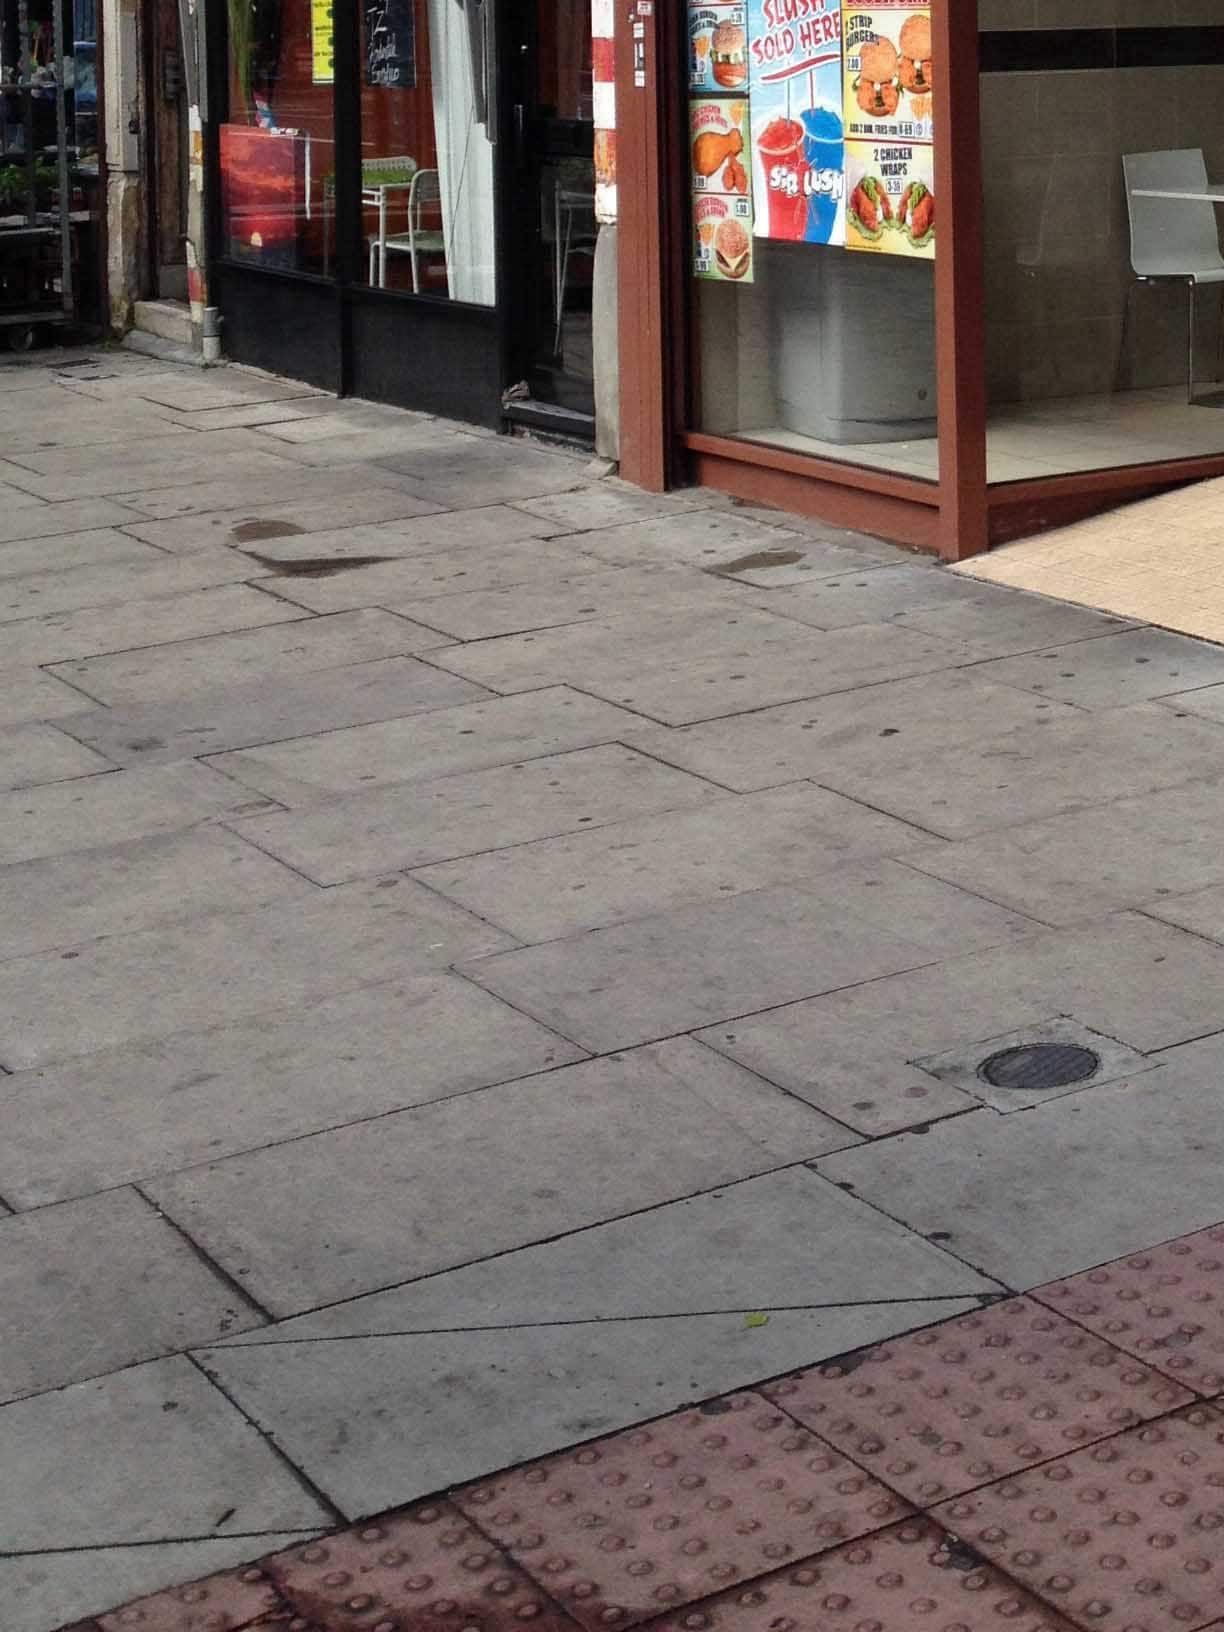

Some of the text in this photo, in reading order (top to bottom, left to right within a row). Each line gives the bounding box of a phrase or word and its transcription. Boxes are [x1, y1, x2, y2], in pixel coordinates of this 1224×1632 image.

[849, 14, 872, 30] STRIP
[752, 11, 841, 64] SOLD HERE
[874, 147, 913, 162] 2 CHICKEN
[880, 162, 908, 176] WRAPS
